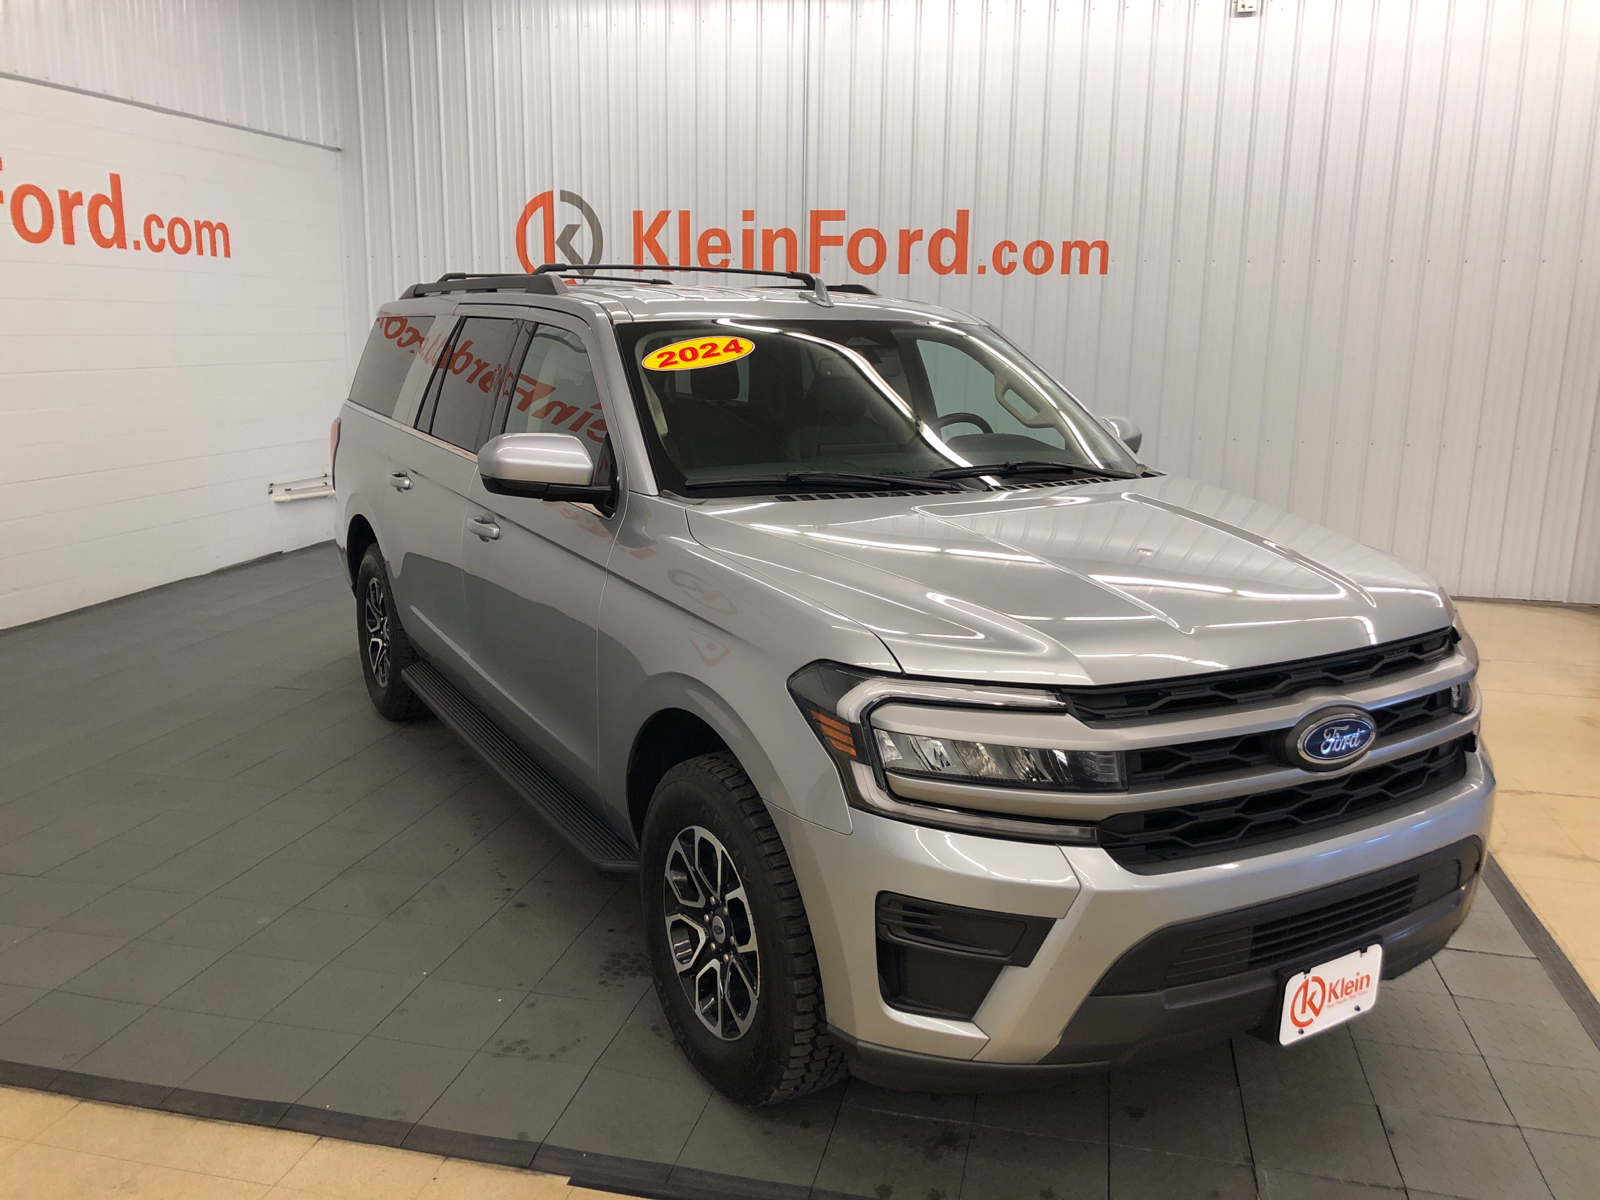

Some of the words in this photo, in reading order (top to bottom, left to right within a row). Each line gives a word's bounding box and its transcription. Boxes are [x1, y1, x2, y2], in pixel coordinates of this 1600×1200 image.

[0, 157, 231, 258] ord.com
[632, 209, 1110, 276] KleinFord.com
[656, 338, 744, 368] 2024
[1319, 724, 1363, 755] Ford
[1327, 971, 1371, 1003] Klein
